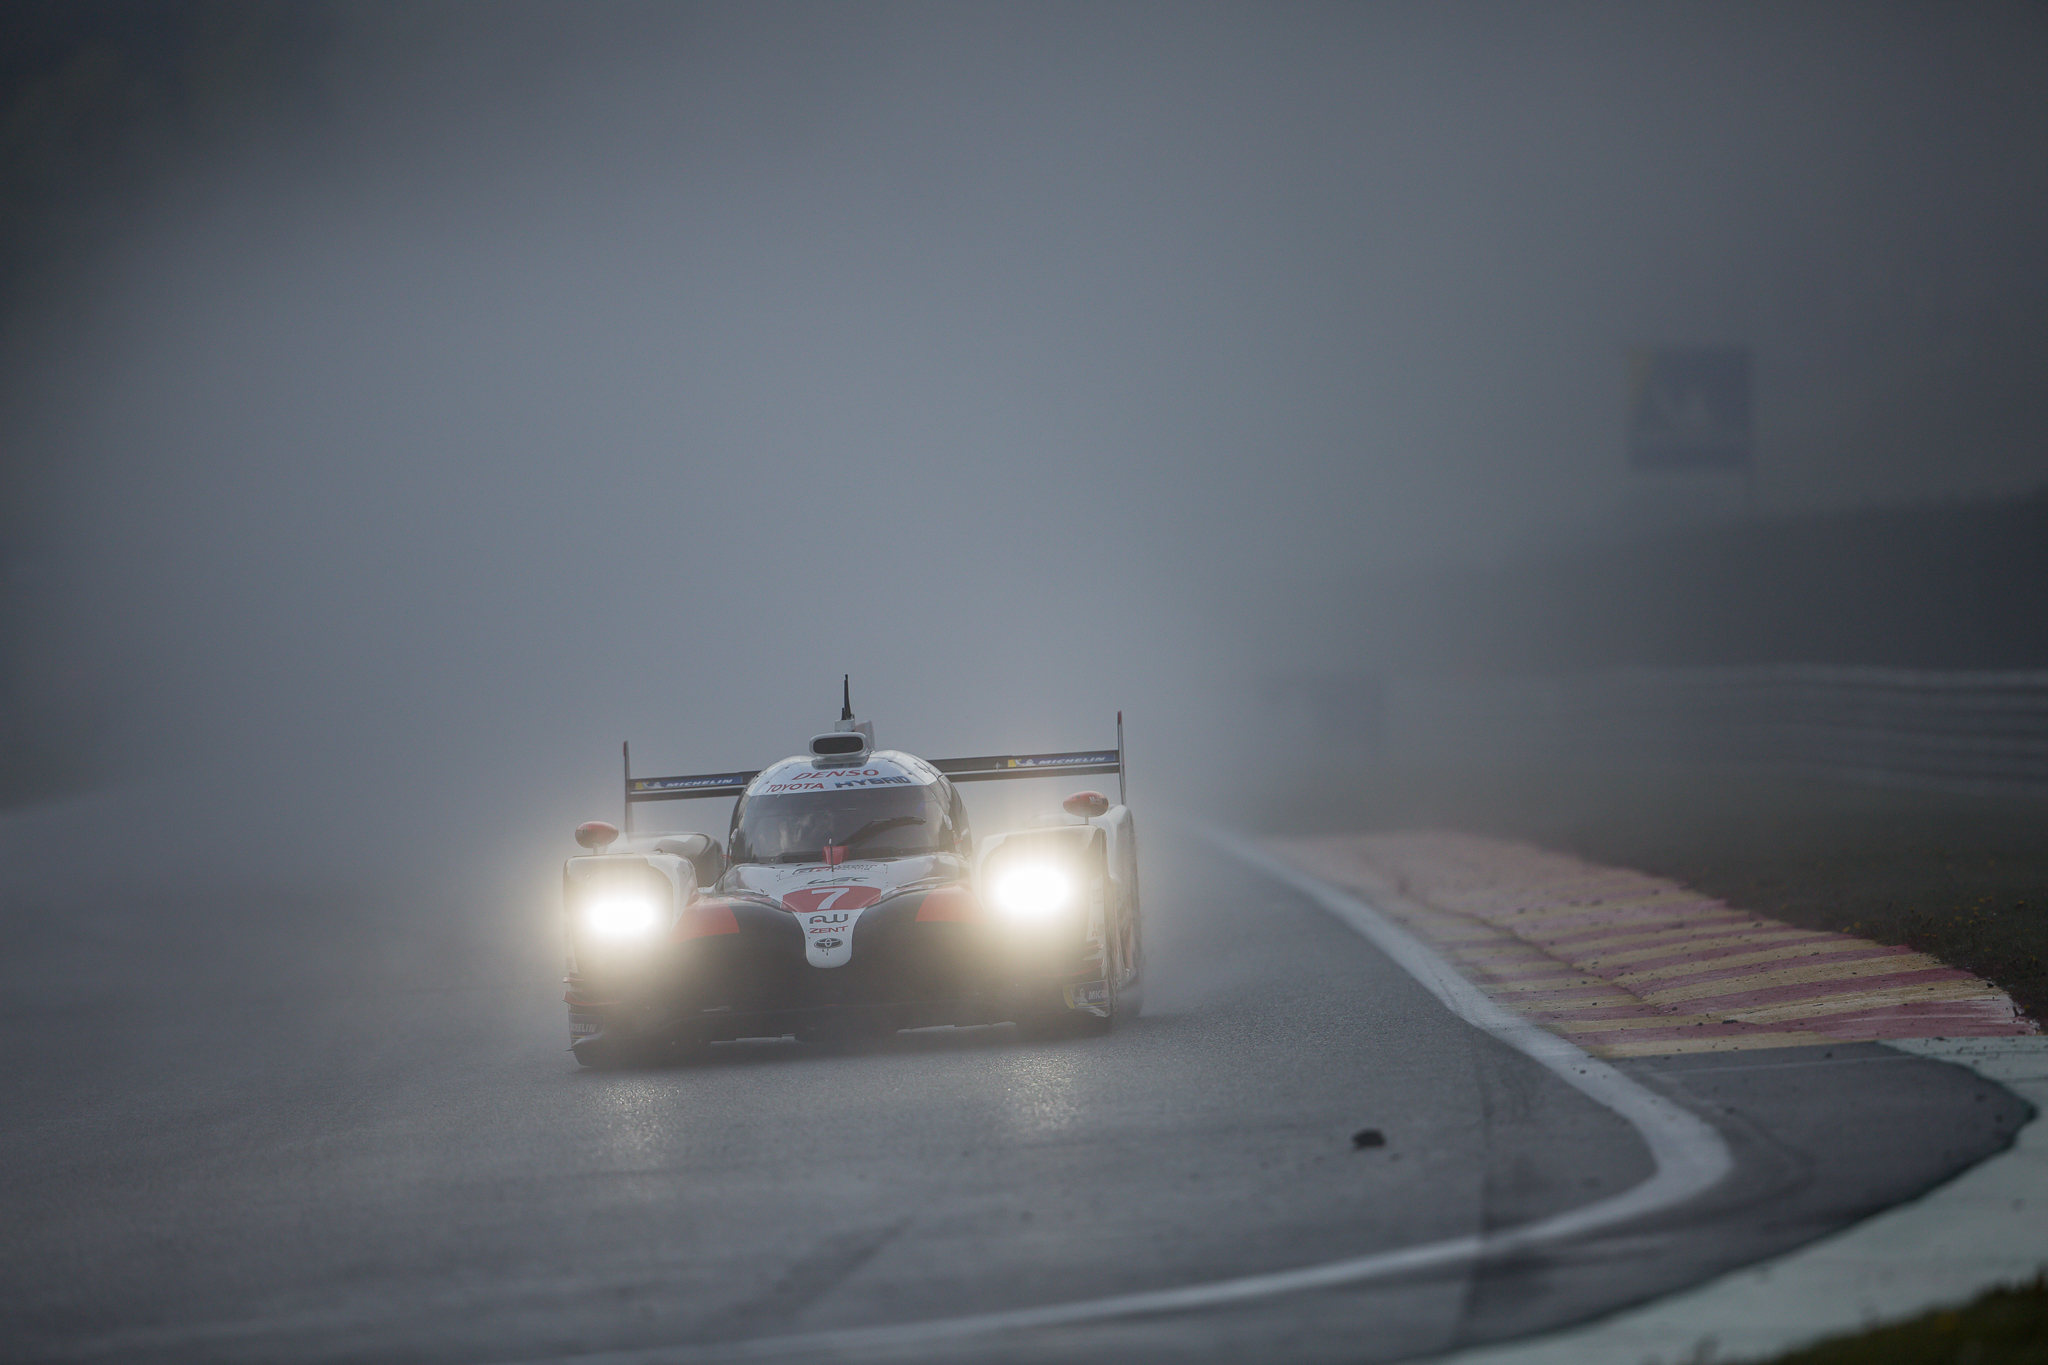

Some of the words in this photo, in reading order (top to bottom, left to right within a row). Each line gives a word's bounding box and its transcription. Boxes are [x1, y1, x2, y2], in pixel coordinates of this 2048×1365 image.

[1038, 756, 1106, 765] MICHELIN
[791, 769, 879, 781] DENSO
[666, 778, 733, 788] MICHELIN
[765, 782, 825, 793] TOYOTA
[834, 775, 911, 789] HYBRID
[811, 887, 849, 910] 7
[809, 925, 849, 934] ZENT
